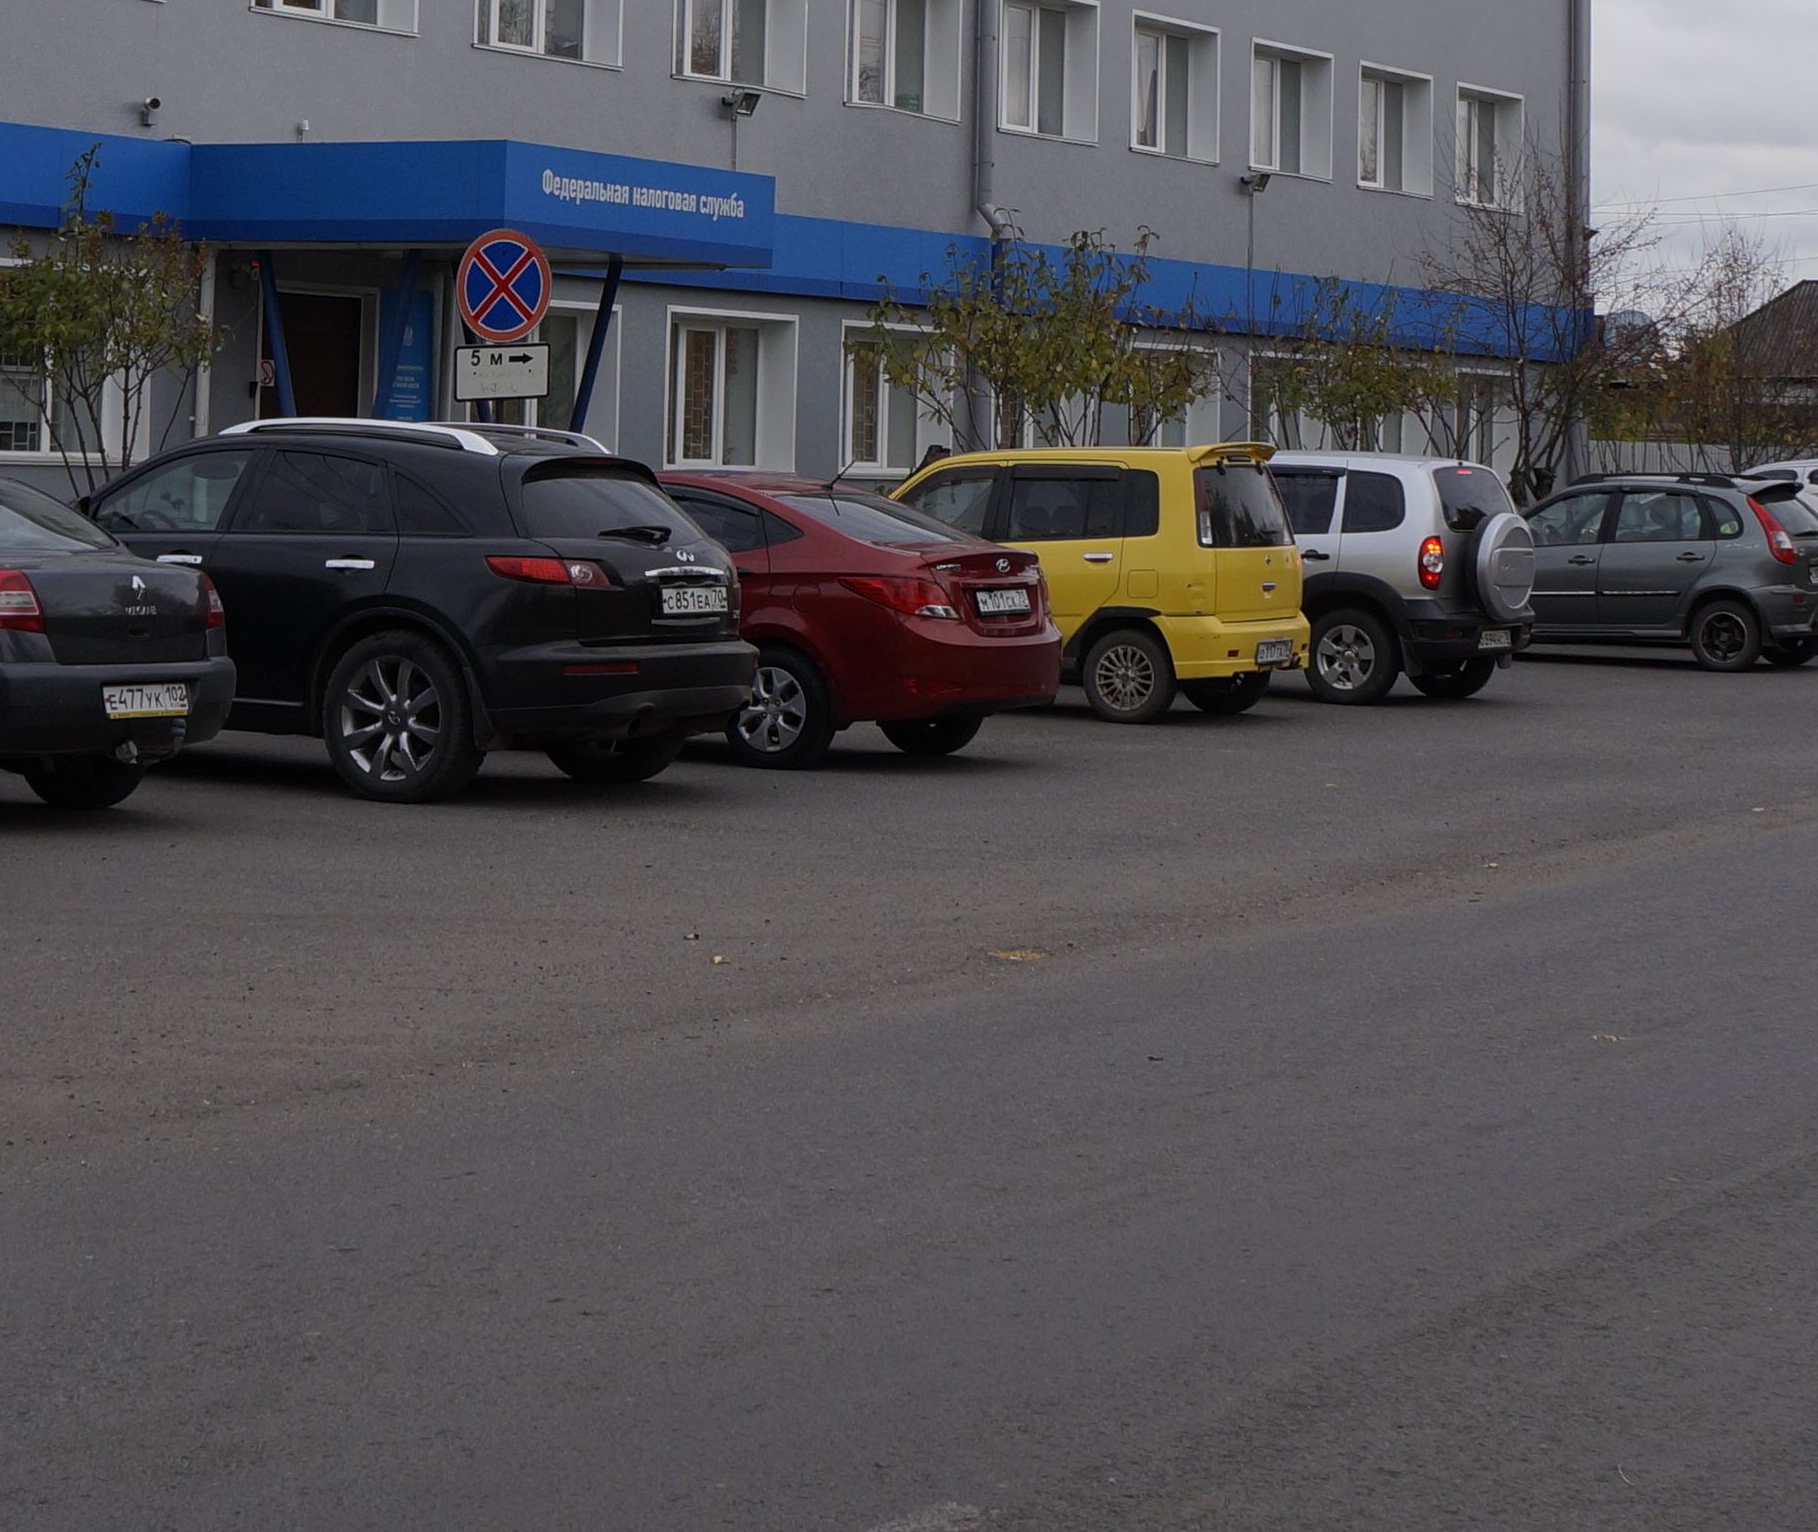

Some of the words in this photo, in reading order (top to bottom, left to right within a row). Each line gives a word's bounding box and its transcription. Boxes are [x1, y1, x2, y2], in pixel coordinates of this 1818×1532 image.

[542, 169, 630, 205] Федеральная
[632, 186, 696, 213] налоговая
[699, 192, 745, 222] служба
[471, 350, 481, 366] 5
[667, 590, 711, 610] С851ЕА
[108, 688, 163, 710] Е477УК
[165, 685, 185, 701] 102
